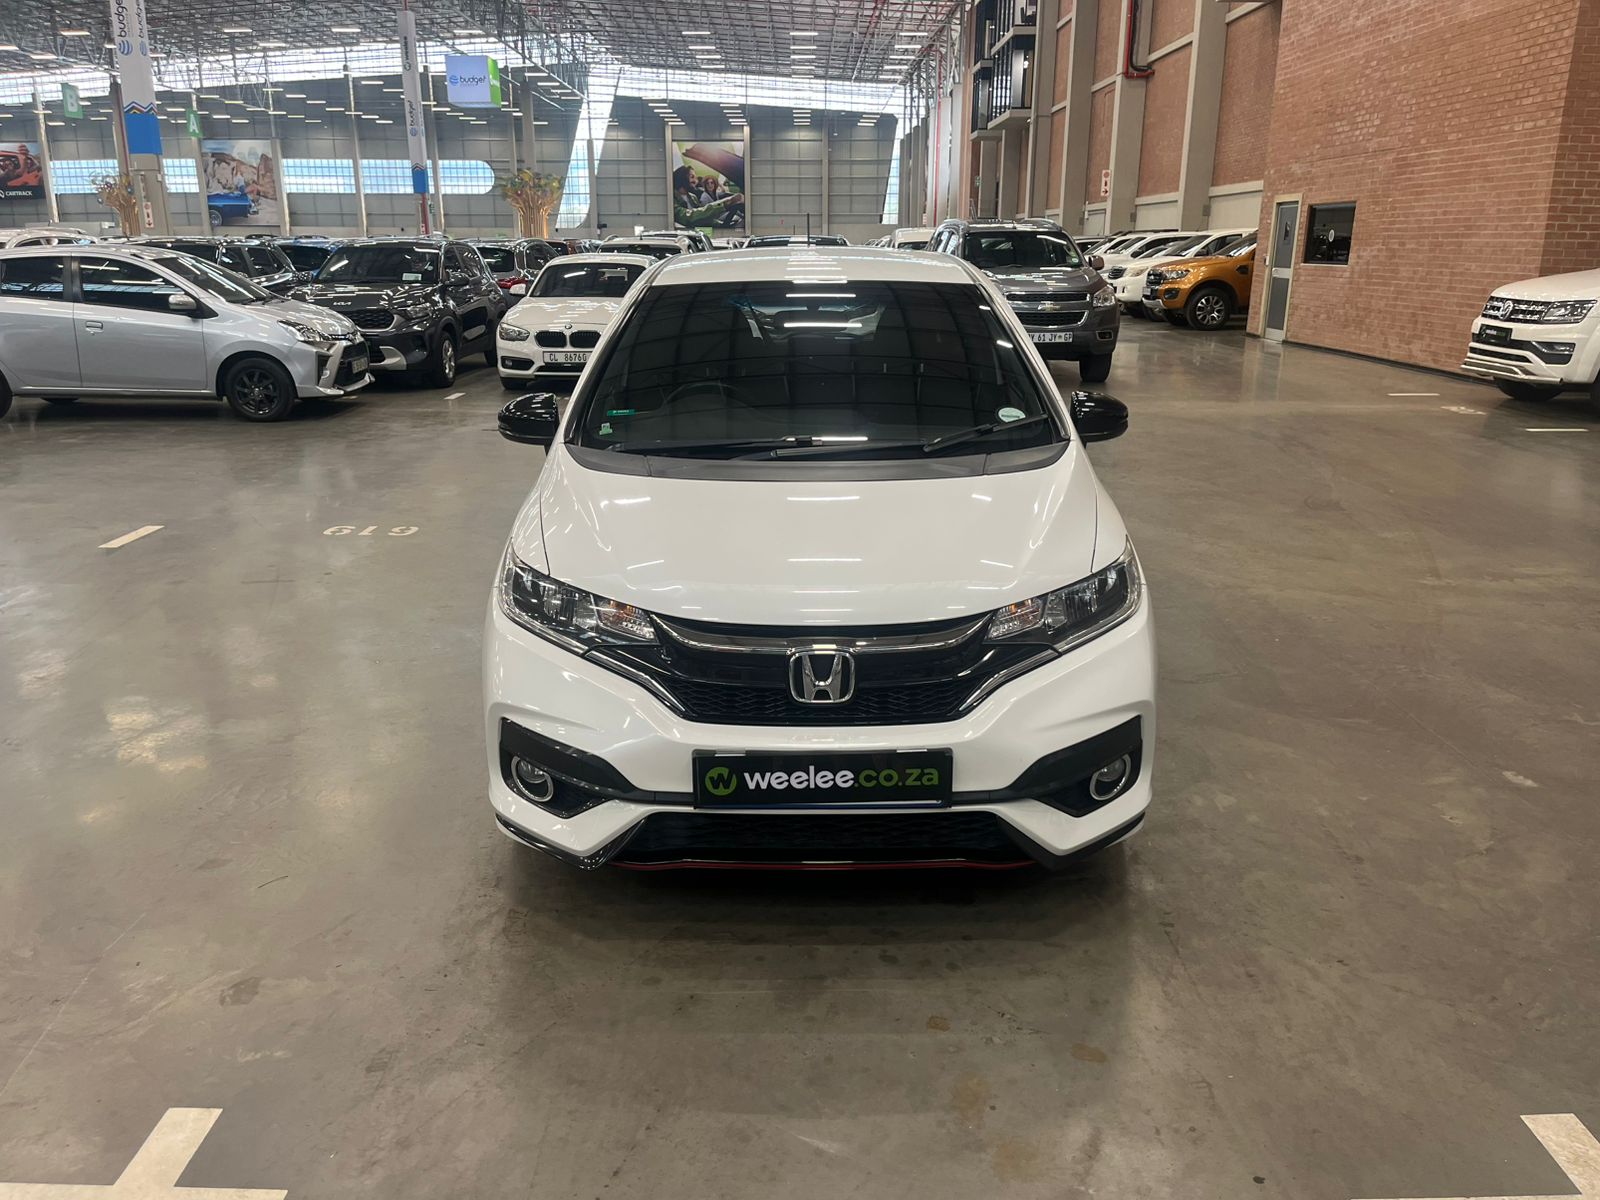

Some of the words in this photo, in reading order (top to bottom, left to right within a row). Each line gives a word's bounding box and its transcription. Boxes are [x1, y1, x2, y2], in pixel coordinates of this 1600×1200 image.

[459, 75, 486, 86] budget
[65, 88, 78, 113] B
[189, 113, 199, 134] A
[407, 100, 416, 127] budget
[5, 190, 33, 198] CARTRACK
[1063, 333, 1072, 341] GP
[743, 765, 939, 789] weelee.co.za
